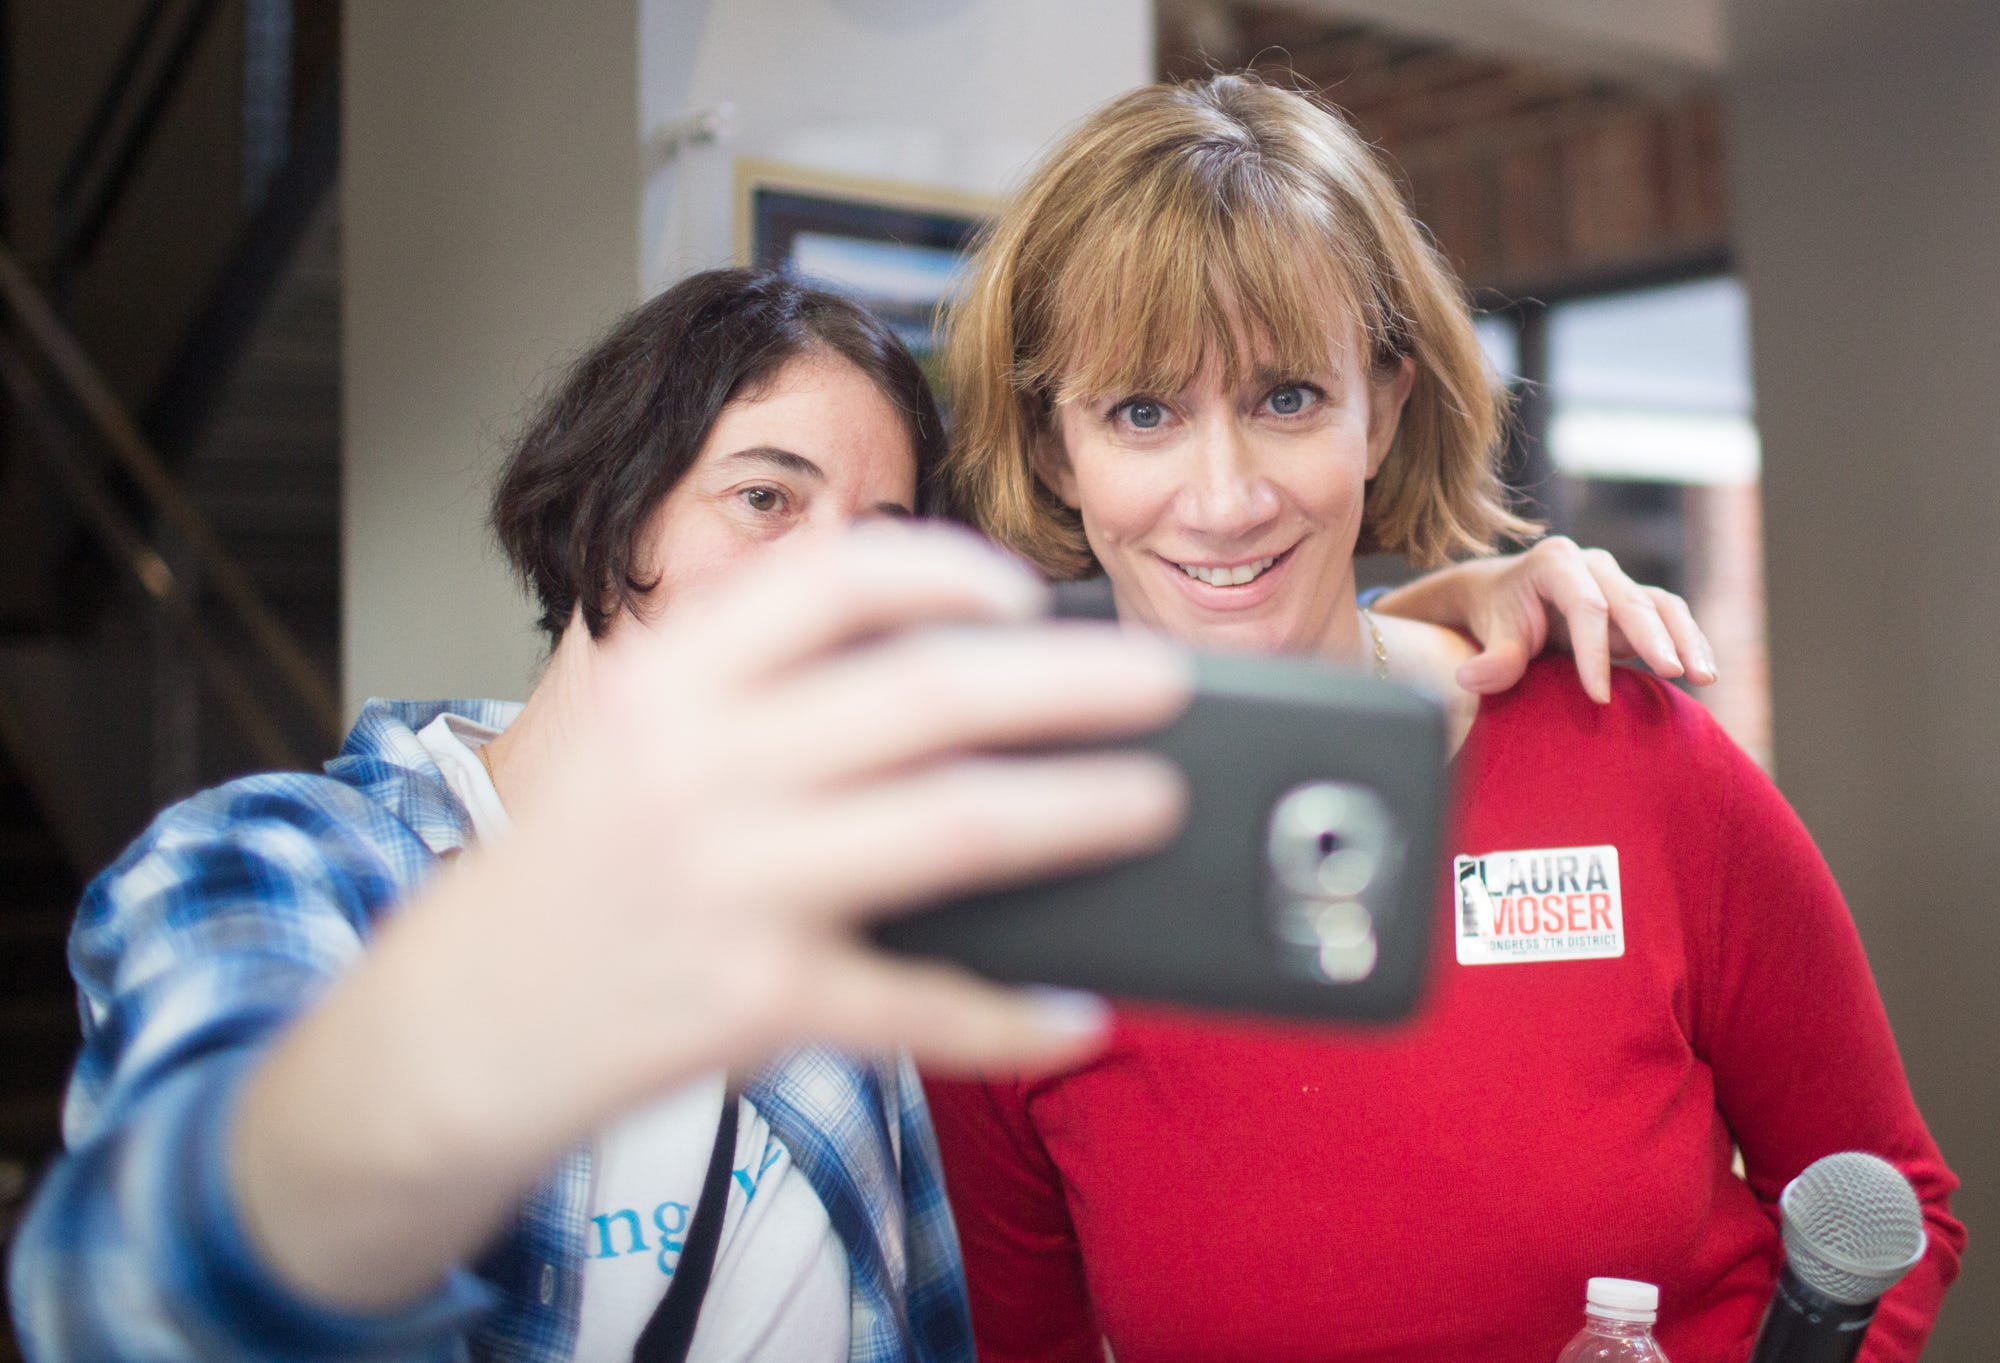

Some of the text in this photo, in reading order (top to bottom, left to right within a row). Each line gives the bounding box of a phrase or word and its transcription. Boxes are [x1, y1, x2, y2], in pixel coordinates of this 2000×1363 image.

[1479, 855, 1609, 896] LAURA
[1488, 937, 1540, 951] ONGRESS
[1543, 937, 1564, 949] 7TH
[1567, 935, 1617, 948] DISTRICT
[586, 1201, 690, 1275] ng
